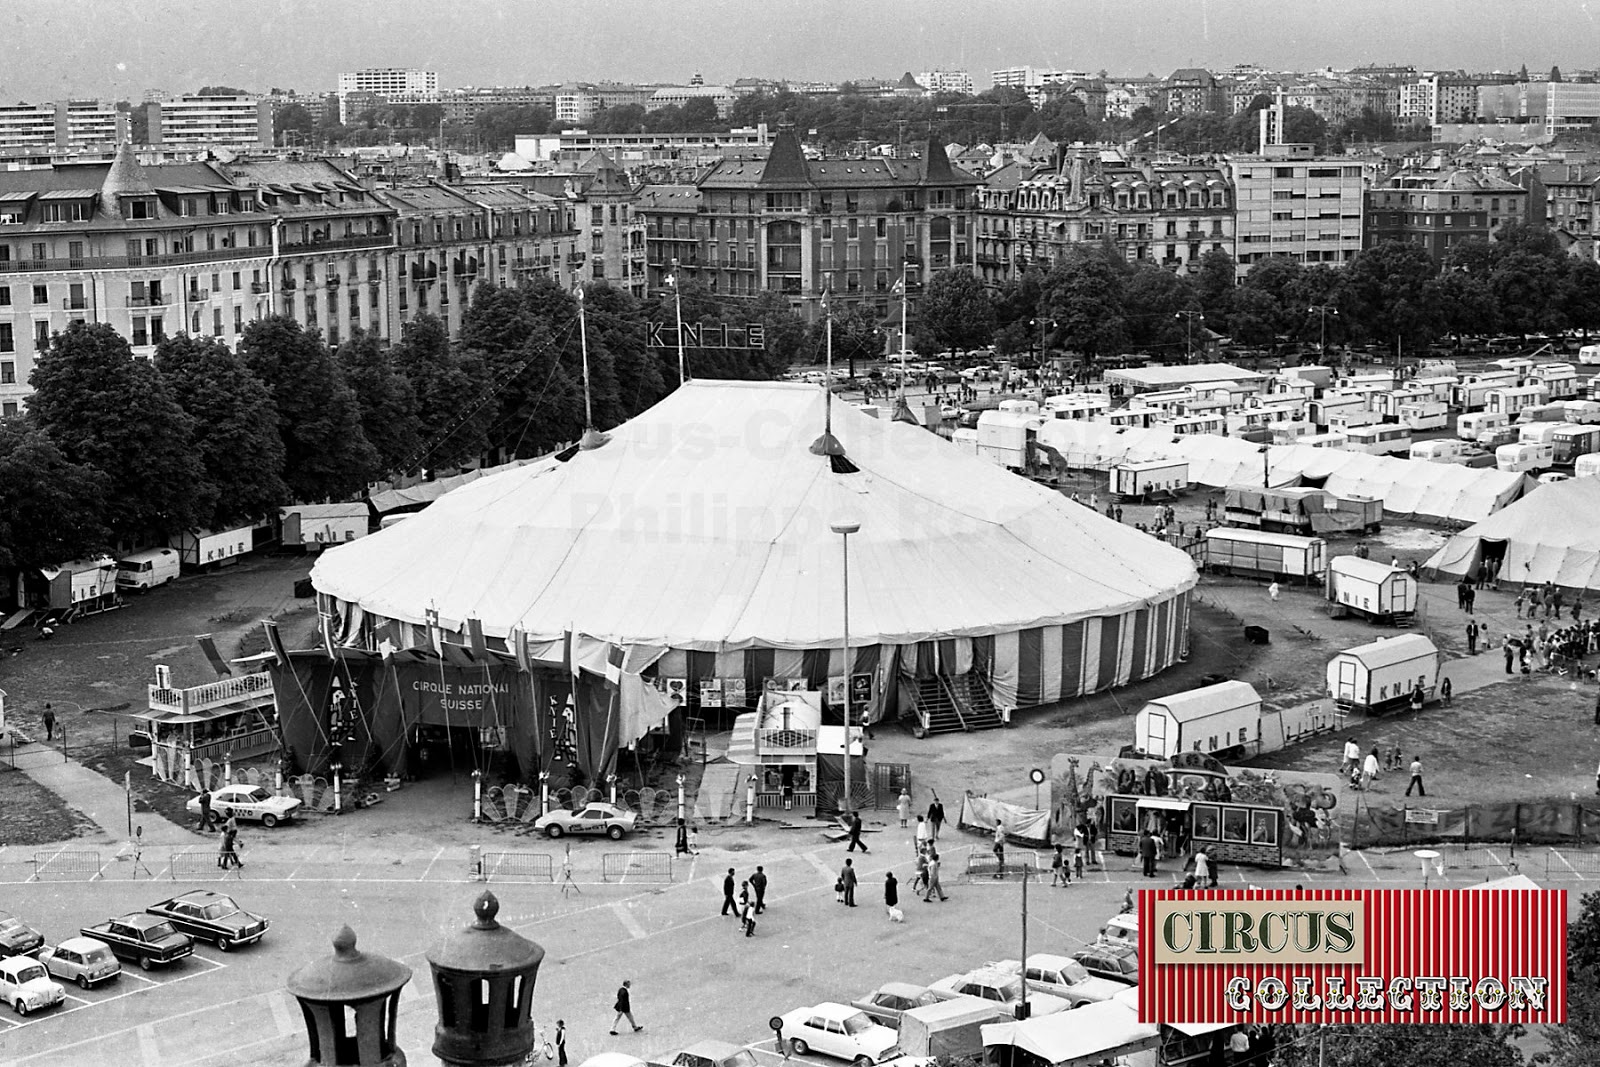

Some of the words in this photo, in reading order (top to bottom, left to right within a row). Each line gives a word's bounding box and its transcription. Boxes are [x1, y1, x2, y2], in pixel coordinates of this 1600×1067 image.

[646, 322, 765, 350] KNIE
[207, 542, 245, 561] KNIE
[412, 681, 453, 695] CIRQUE
[1380, 675, 1426, 700] KNIE
[440, 699, 482, 710] SUISSE
[549, 694, 559, 739] KNIE
[1193, 727, 1248, 752] KNIE
